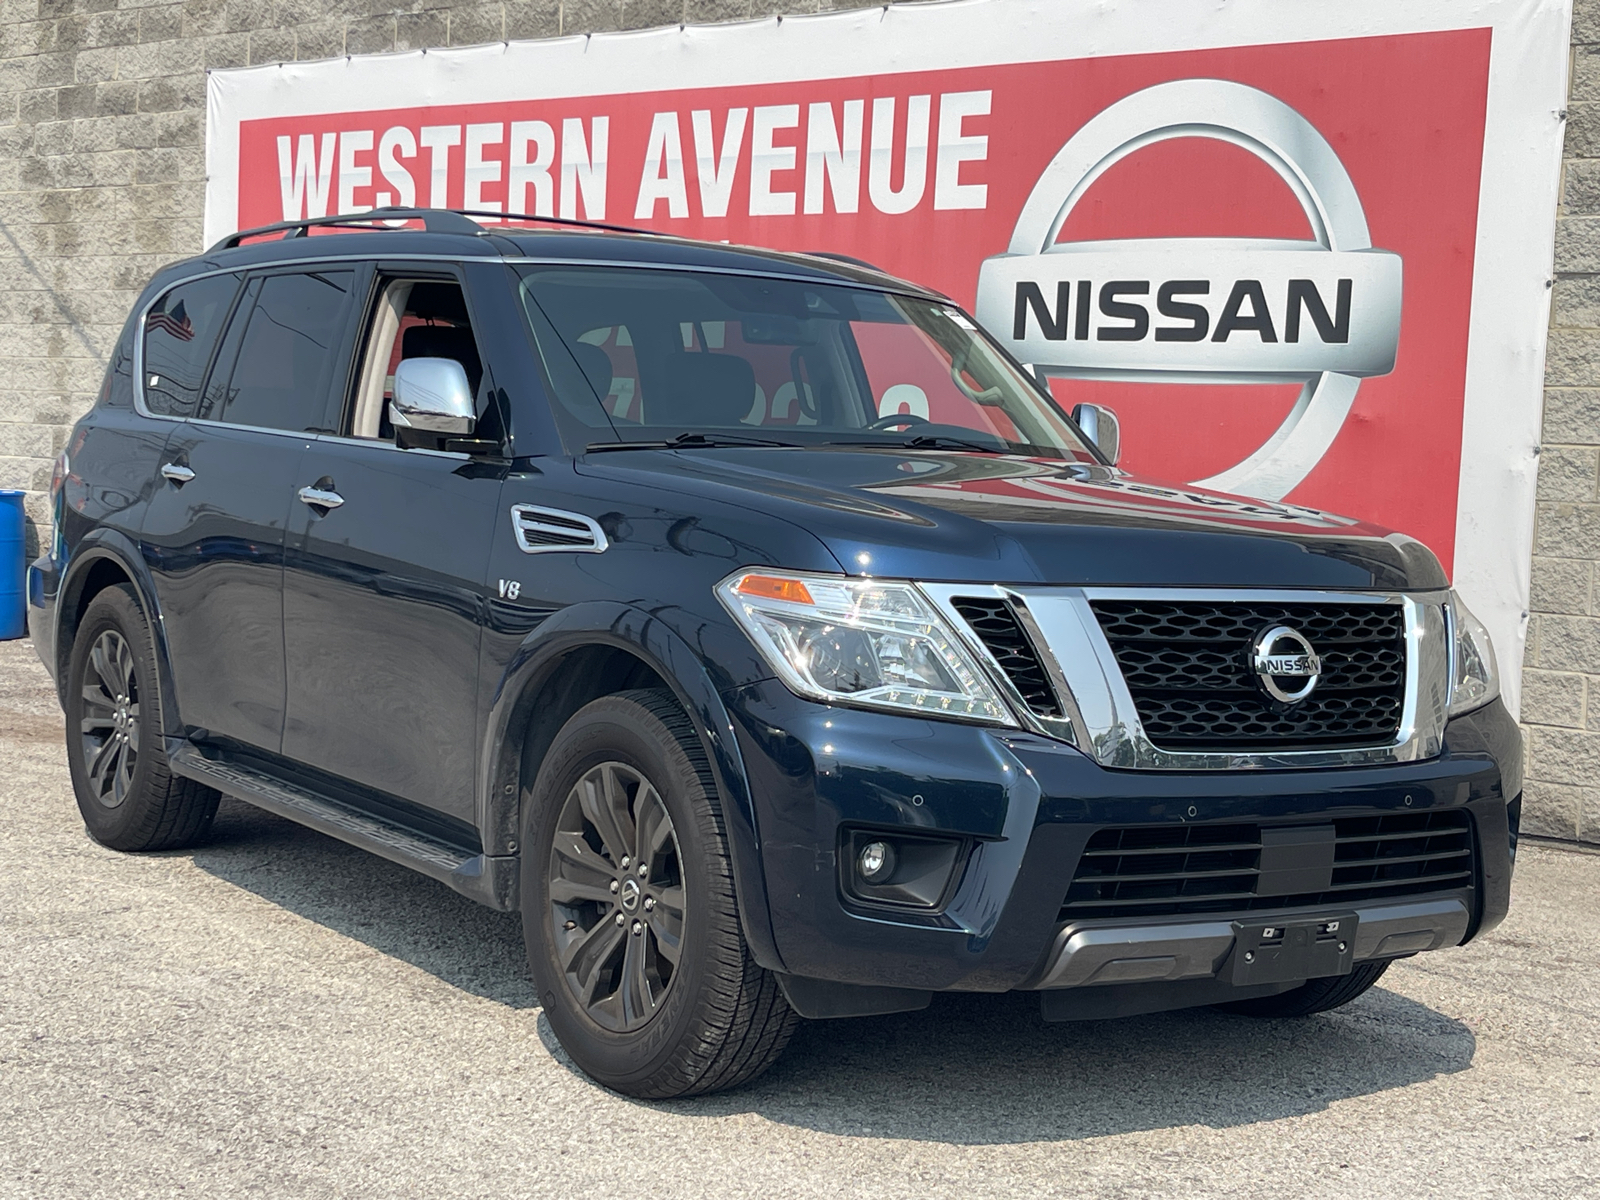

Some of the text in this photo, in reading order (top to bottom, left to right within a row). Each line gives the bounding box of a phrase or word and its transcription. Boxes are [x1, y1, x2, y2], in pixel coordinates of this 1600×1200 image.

[276, 89, 993, 226] WESTERN AVENUE
[1012, 279, 1353, 344] NISSAN
[499, 579, 520, 600] V8
[1266, 659, 1319, 671] NISSAN
